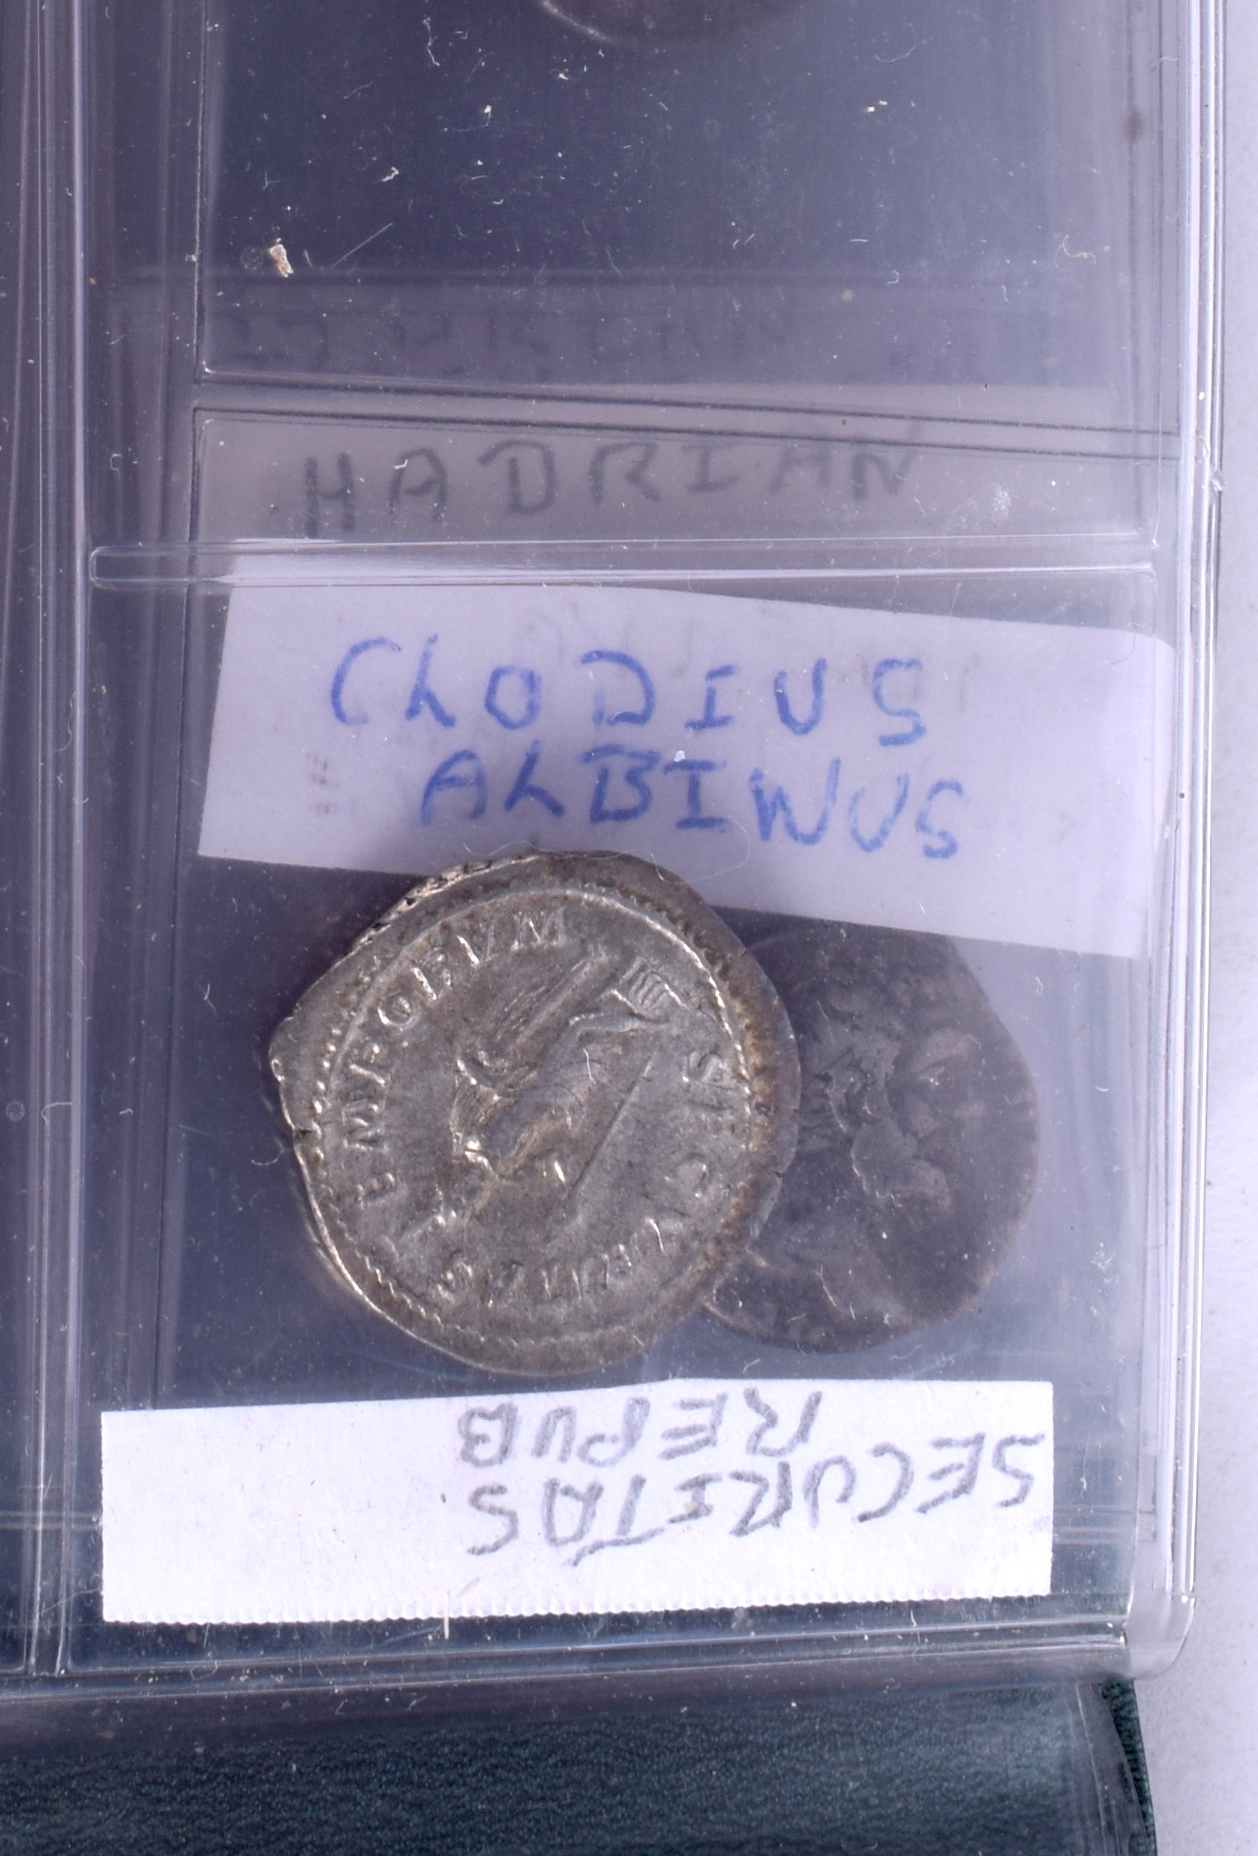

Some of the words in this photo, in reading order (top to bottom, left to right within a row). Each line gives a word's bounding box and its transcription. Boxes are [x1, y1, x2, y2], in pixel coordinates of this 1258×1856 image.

[300, 422, 920, 538] HADRIAN
[330, 633, 929, 747] CLODIUS
[420, 741, 968, 860] ALBINUS
[457, 1386, 823, 1468] REPUB
[467, 1431, 1045, 1569] SECURITAS
